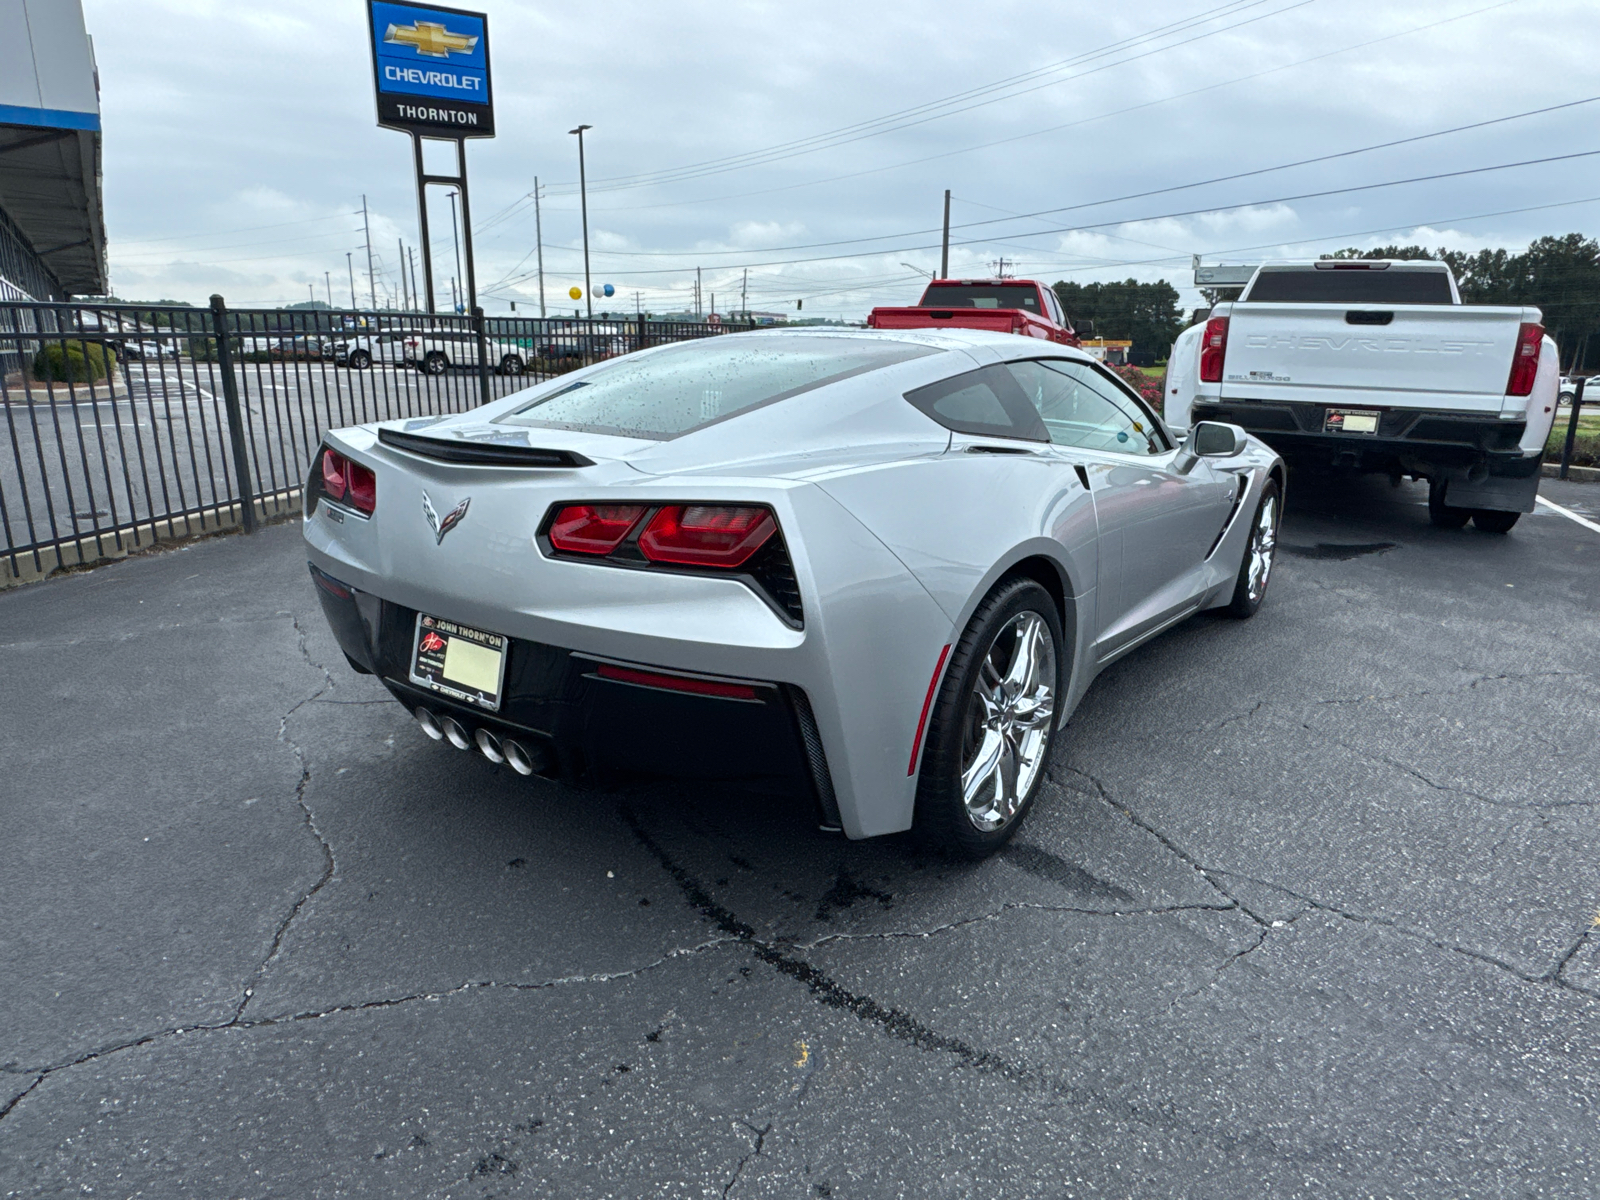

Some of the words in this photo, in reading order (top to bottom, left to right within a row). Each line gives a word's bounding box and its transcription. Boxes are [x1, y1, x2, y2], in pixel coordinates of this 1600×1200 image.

[385, 65, 481, 91] CHEVROLET
[397, 104, 477, 125] THORNTON
[1245, 334, 1495, 355] CHEVROLET
[436, 620, 457, 634] JOHN
[440, 686, 466, 700] CHEVROLET
